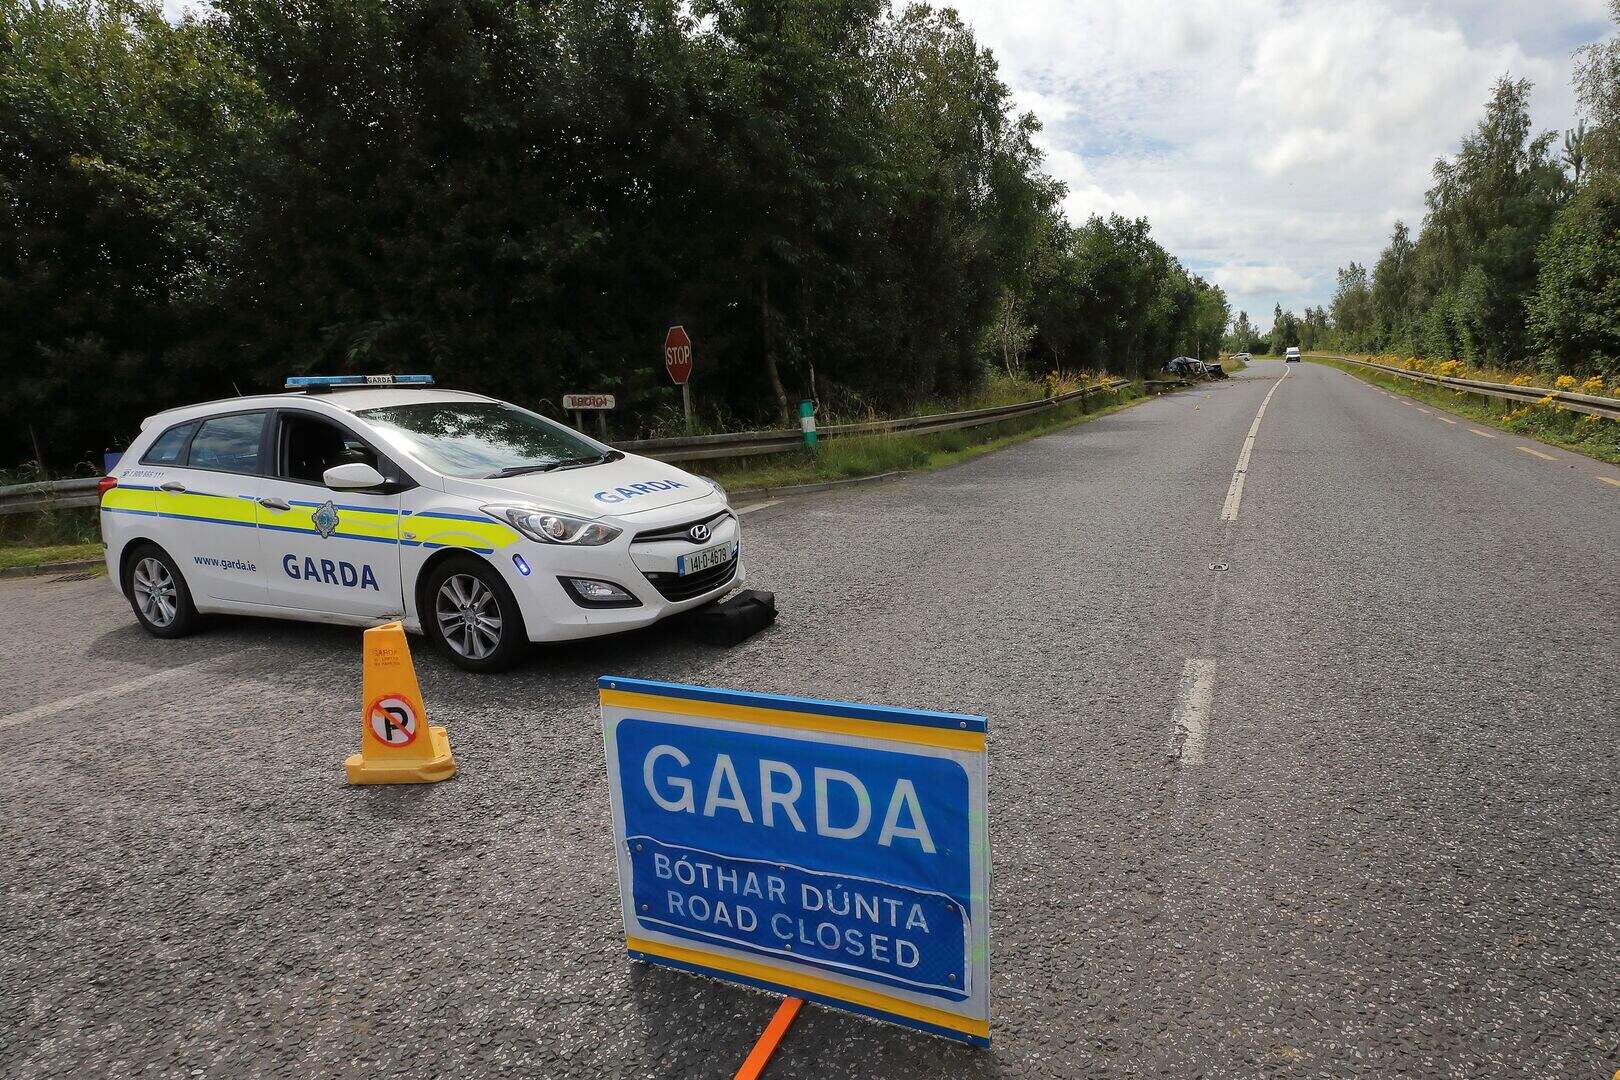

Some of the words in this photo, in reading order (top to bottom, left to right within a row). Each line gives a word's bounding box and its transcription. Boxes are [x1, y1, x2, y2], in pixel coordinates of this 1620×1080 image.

[666, 345, 691, 366] STOP
[593, 479, 689, 504] GARDA
[193, 555, 257, 571] www.garda.ie
[282, 553, 380, 592] GARDA
[642, 744, 937, 855] GARDA
[654, 852, 787, 905] BÓTHAR
[801, 883, 930, 934] DÚNTA
[667, 890, 758, 932] ROAD
[770, 913, 921, 969] CLOSED
